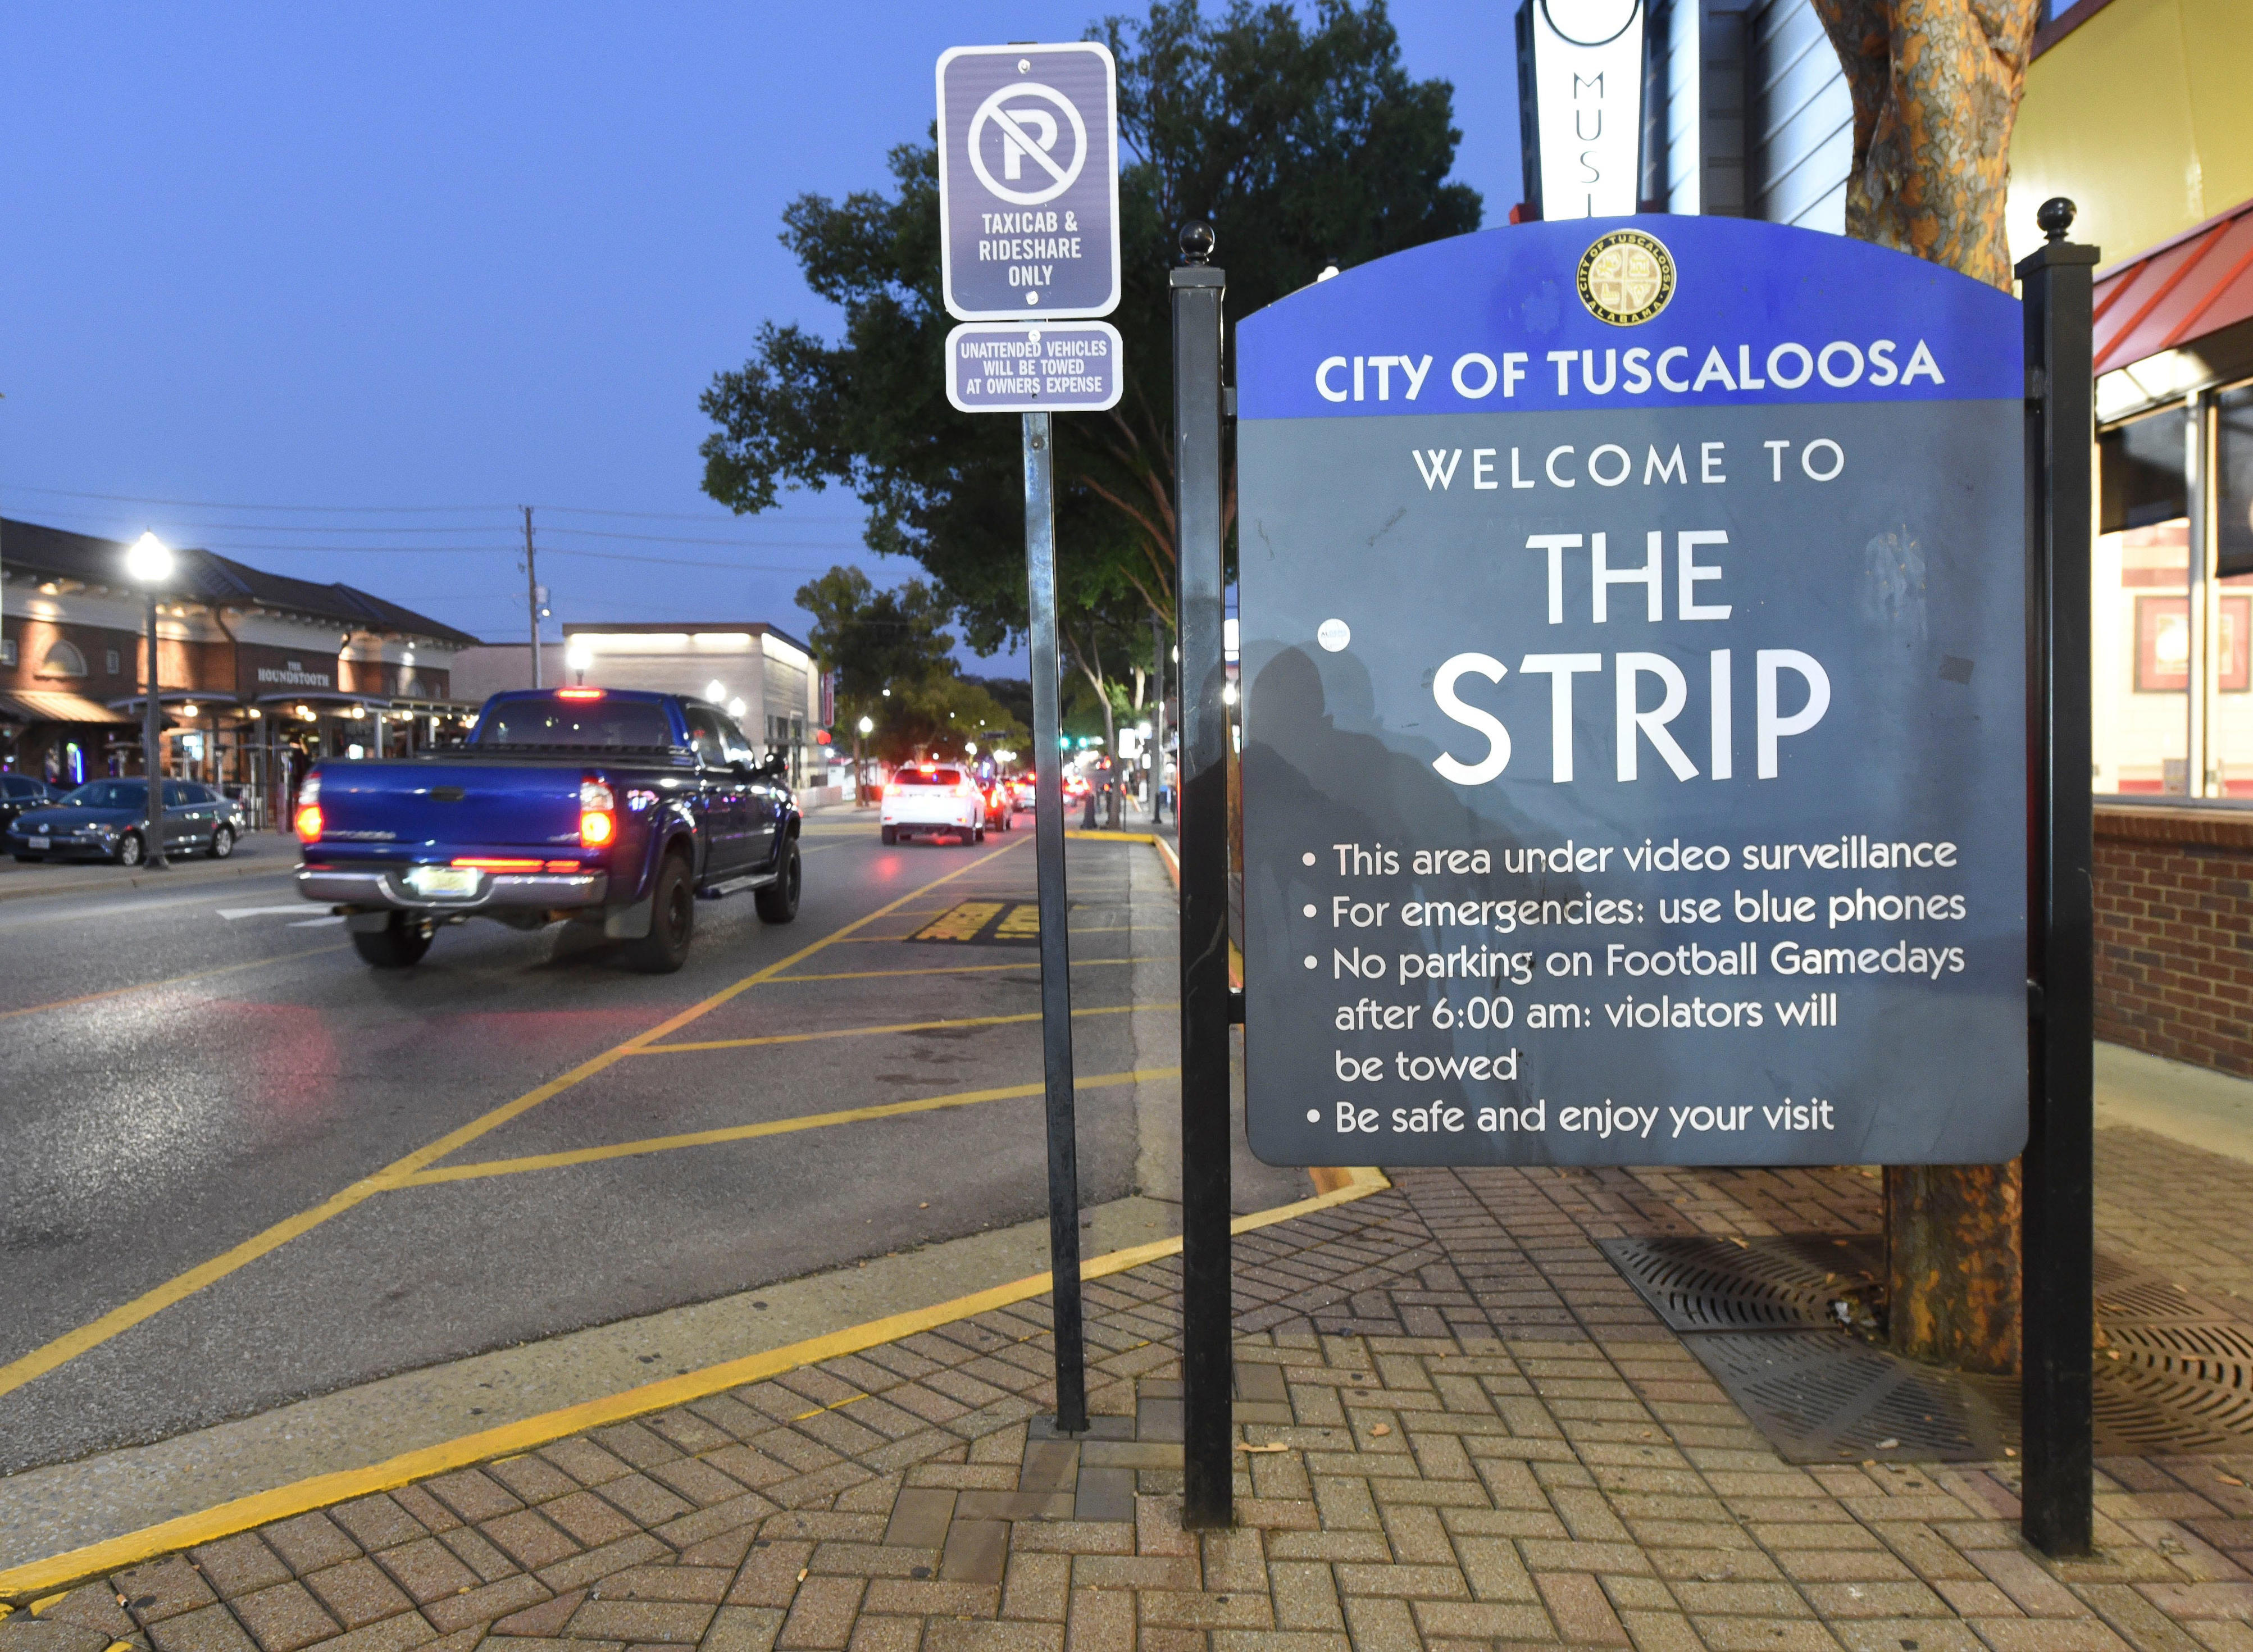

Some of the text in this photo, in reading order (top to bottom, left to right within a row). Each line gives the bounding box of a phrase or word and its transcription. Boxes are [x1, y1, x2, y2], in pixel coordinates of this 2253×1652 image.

[982, 211, 1078, 234] TAXICAB &
[979, 238, 1082, 261] RIDESHARE
[1579, 234, 1671, 292] CITY OF TUSCALOOSA
[1008, 265, 1053, 287] ONLY
[1588, 301, 1663, 323] ALABAMA
[961, 340, 1107, 359] UNATTENDED VEHICLES
[983, 359, 1085, 376] WILL BE TOWED
[966, 376, 1102, 394] AT OWNERS EXPENSE
[1316, 340, 1945, 402] CITY OF TUSCALOOSA
[1412, 438, 1845, 491] WELCOME TO
[1525, 530, 1732, 625] THE
[1432, 648, 1831, 786] STRIP
[1333, 835, 1957, 876] This area under video surveillance
[1333, 887, 1966, 934] For emergencies: use blue phones
[1333, 940, 1965, 986] No parking on Football Gamedays
[1335, 993, 1837, 1031] after 6:00 am: violators will
[1335, 1047, 1518, 1082] be towed
[1336, 1097, 1835, 1139] Be safe and enjoy your visit
